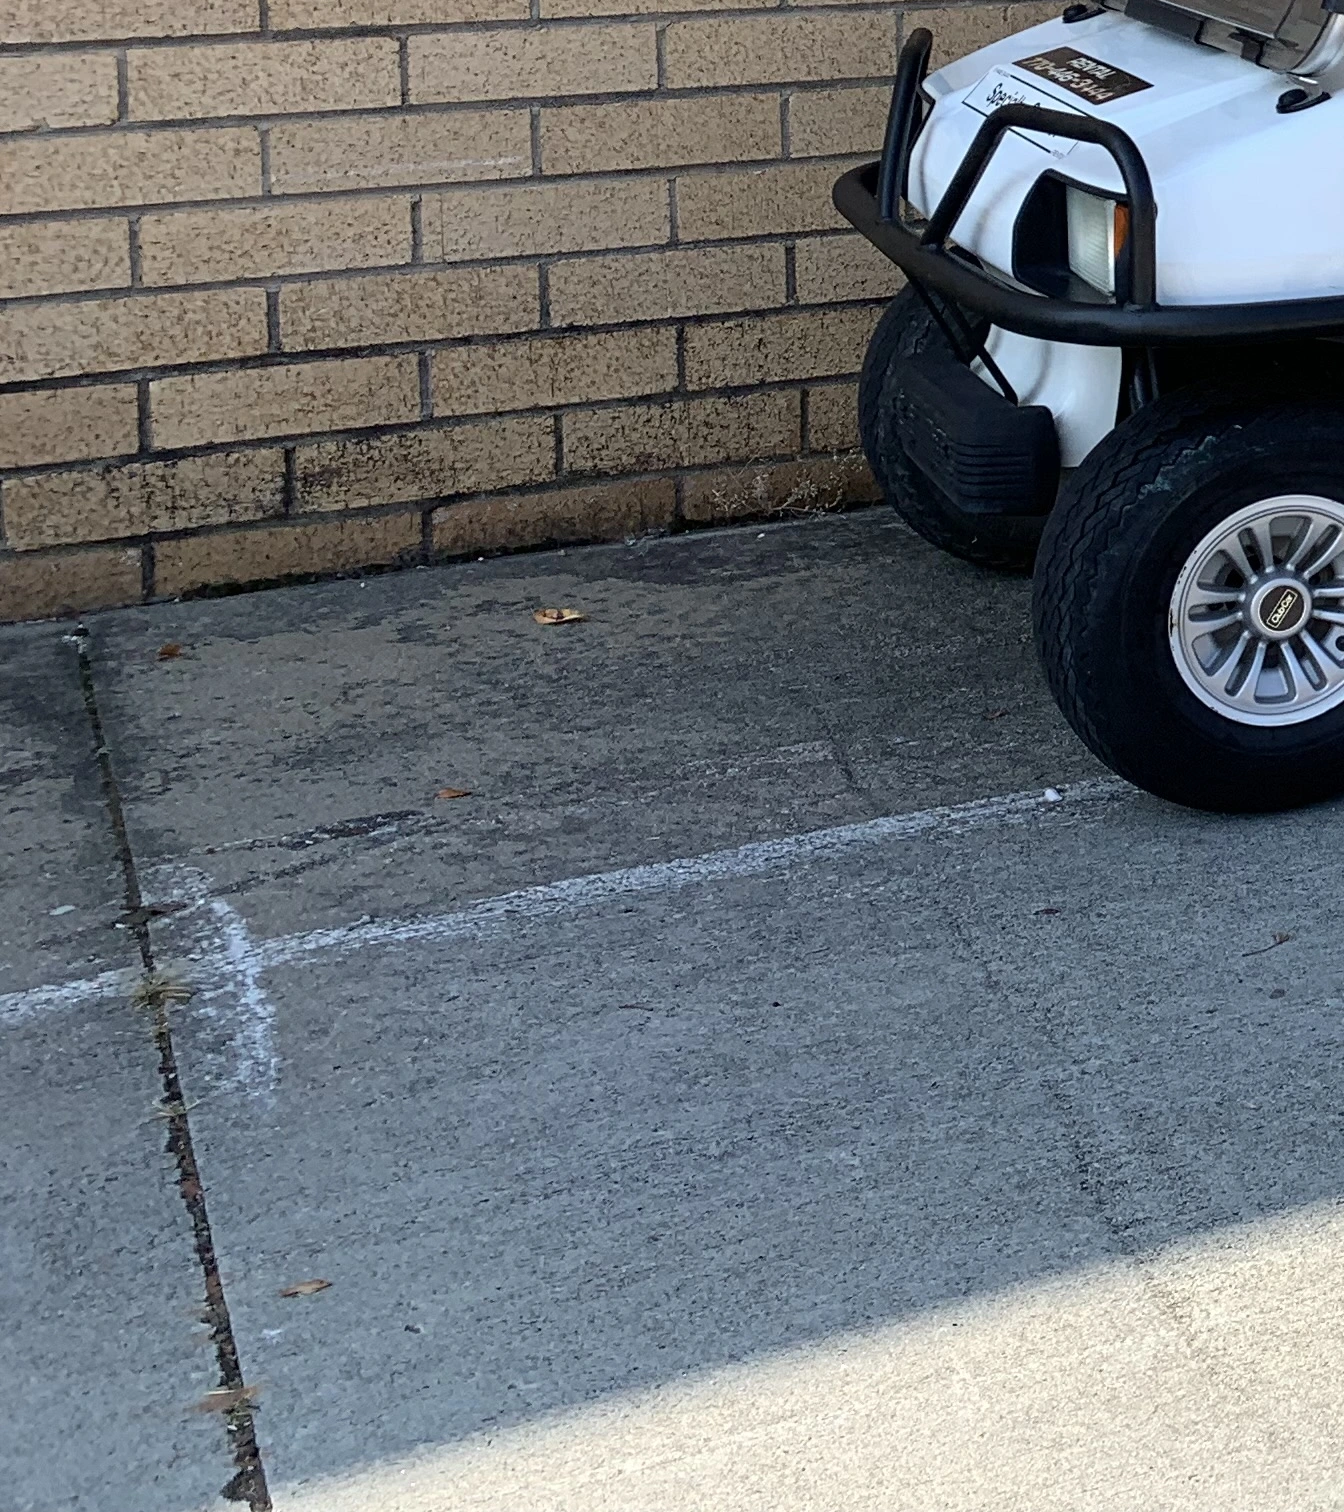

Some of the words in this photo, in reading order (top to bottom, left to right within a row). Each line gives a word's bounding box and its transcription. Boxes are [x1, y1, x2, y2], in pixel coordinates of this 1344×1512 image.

[1066, 57, 1117, 80] RENTAL
[1271, 606, 1285, 623] Club
[1281, 594, 1293, 608] Car
